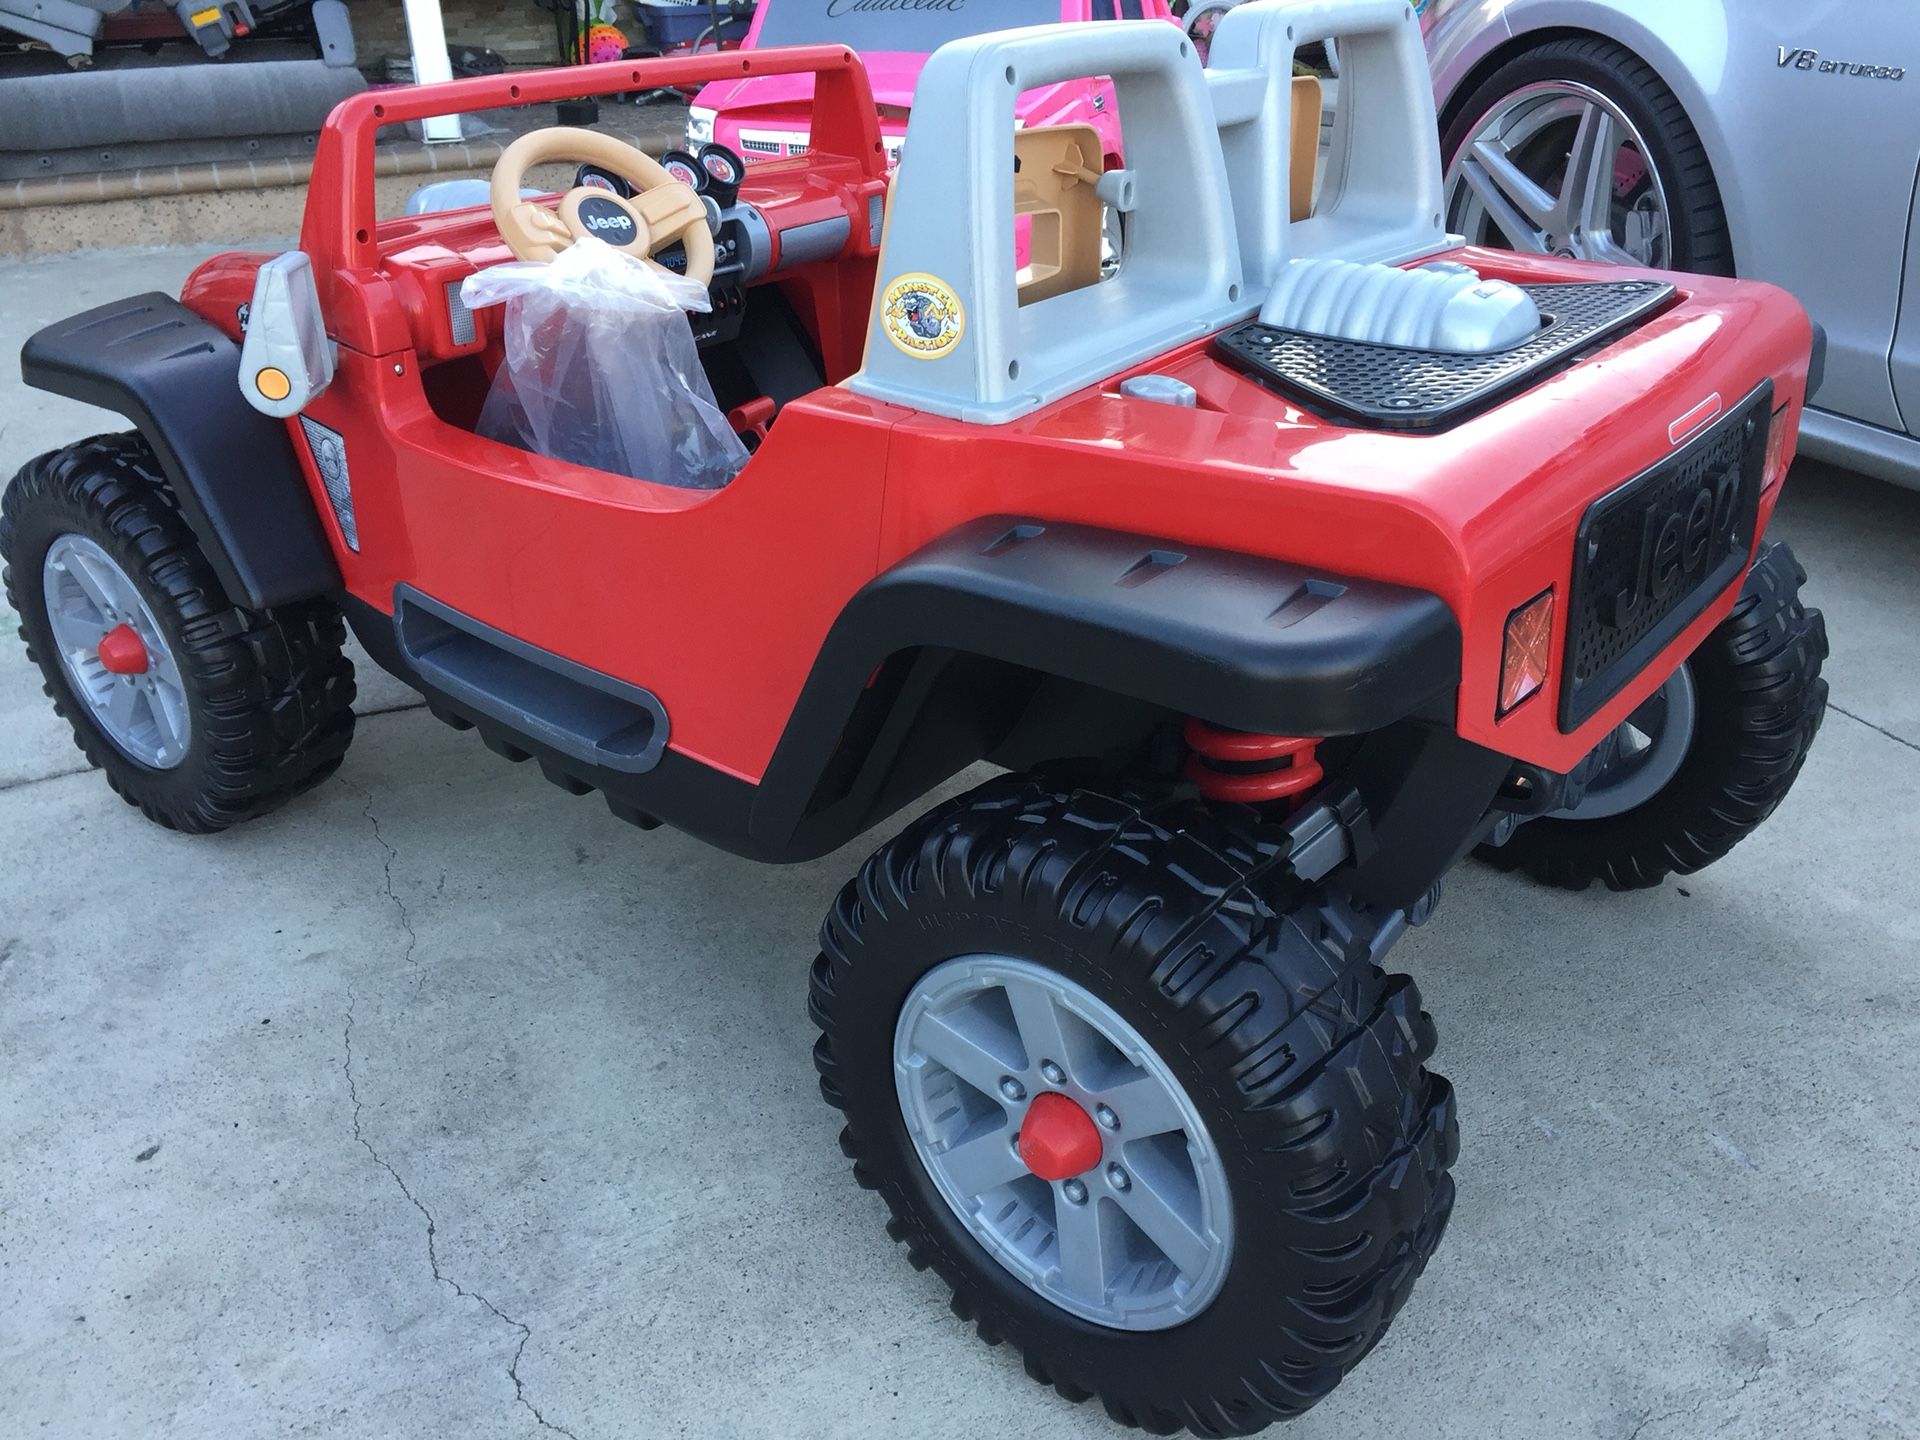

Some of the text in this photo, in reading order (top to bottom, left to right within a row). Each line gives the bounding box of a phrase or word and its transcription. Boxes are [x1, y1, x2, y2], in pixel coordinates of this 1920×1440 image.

[1776, 45, 1906, 81] V8 BITURBO
[586, 215, 632, 230] Jeep
[888, 282, 957, 321] MONSTER
[889, 316, 958, 351] TRACTION
[1615, 464, 1741, 630] Jeep
